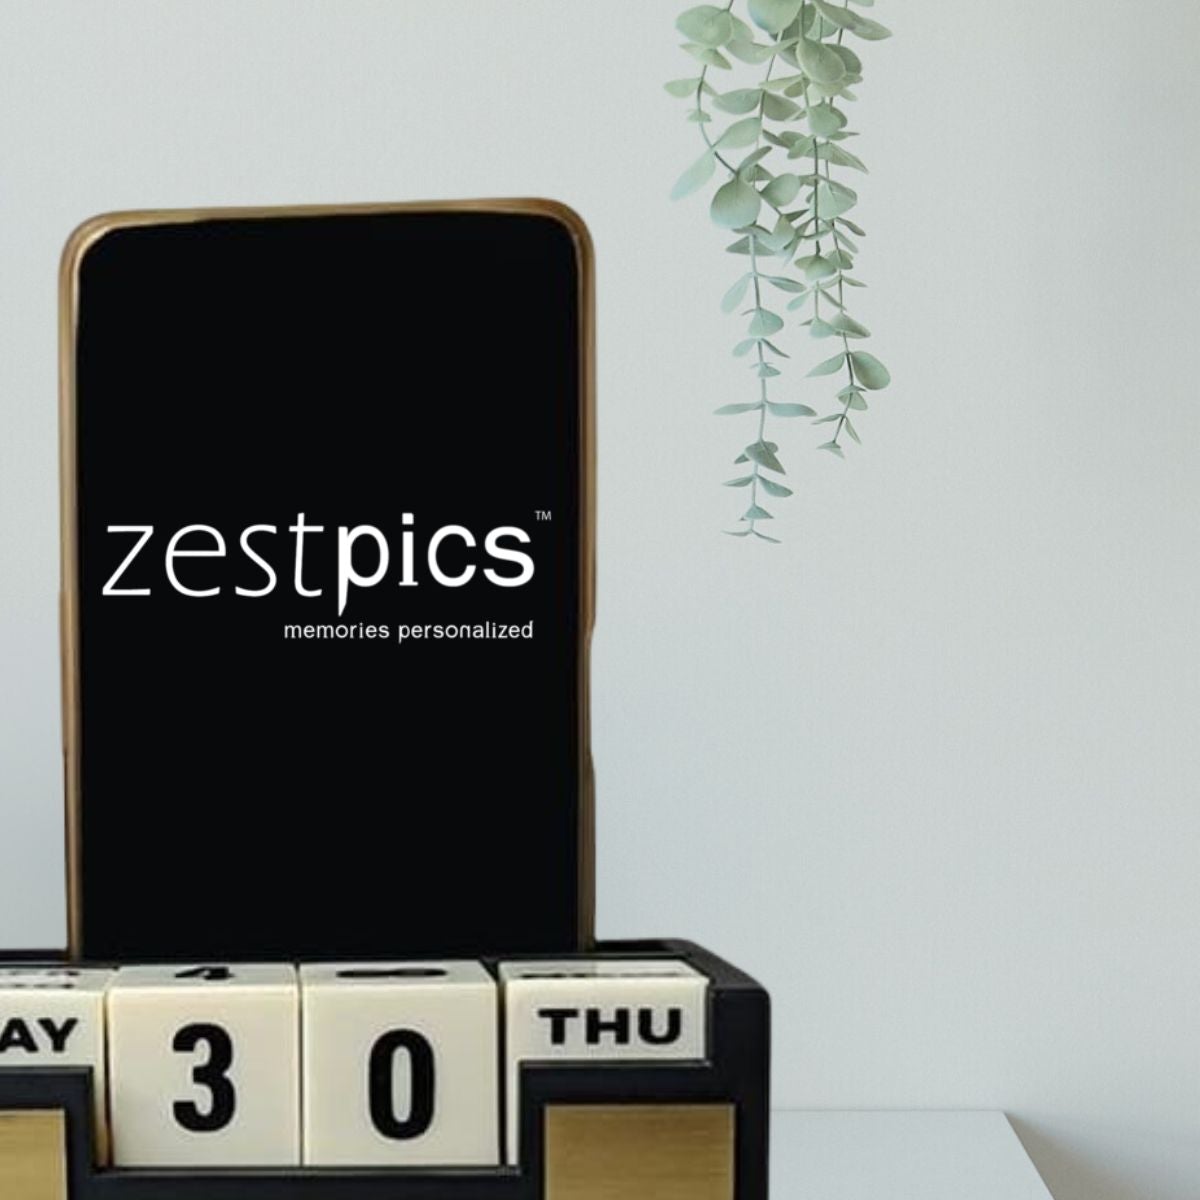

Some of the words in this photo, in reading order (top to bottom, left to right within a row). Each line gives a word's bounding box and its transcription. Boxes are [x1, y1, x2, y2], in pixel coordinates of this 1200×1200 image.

[102, 512, 535, 617] zestpics
[284, 620, 390, 639] memories
[398, 620, 533, 643] personalized
[172, 1023, 236, 1132] 3
[368, 1028, 436, 1141] 0
[538, 1008, 682, 1046] THU
